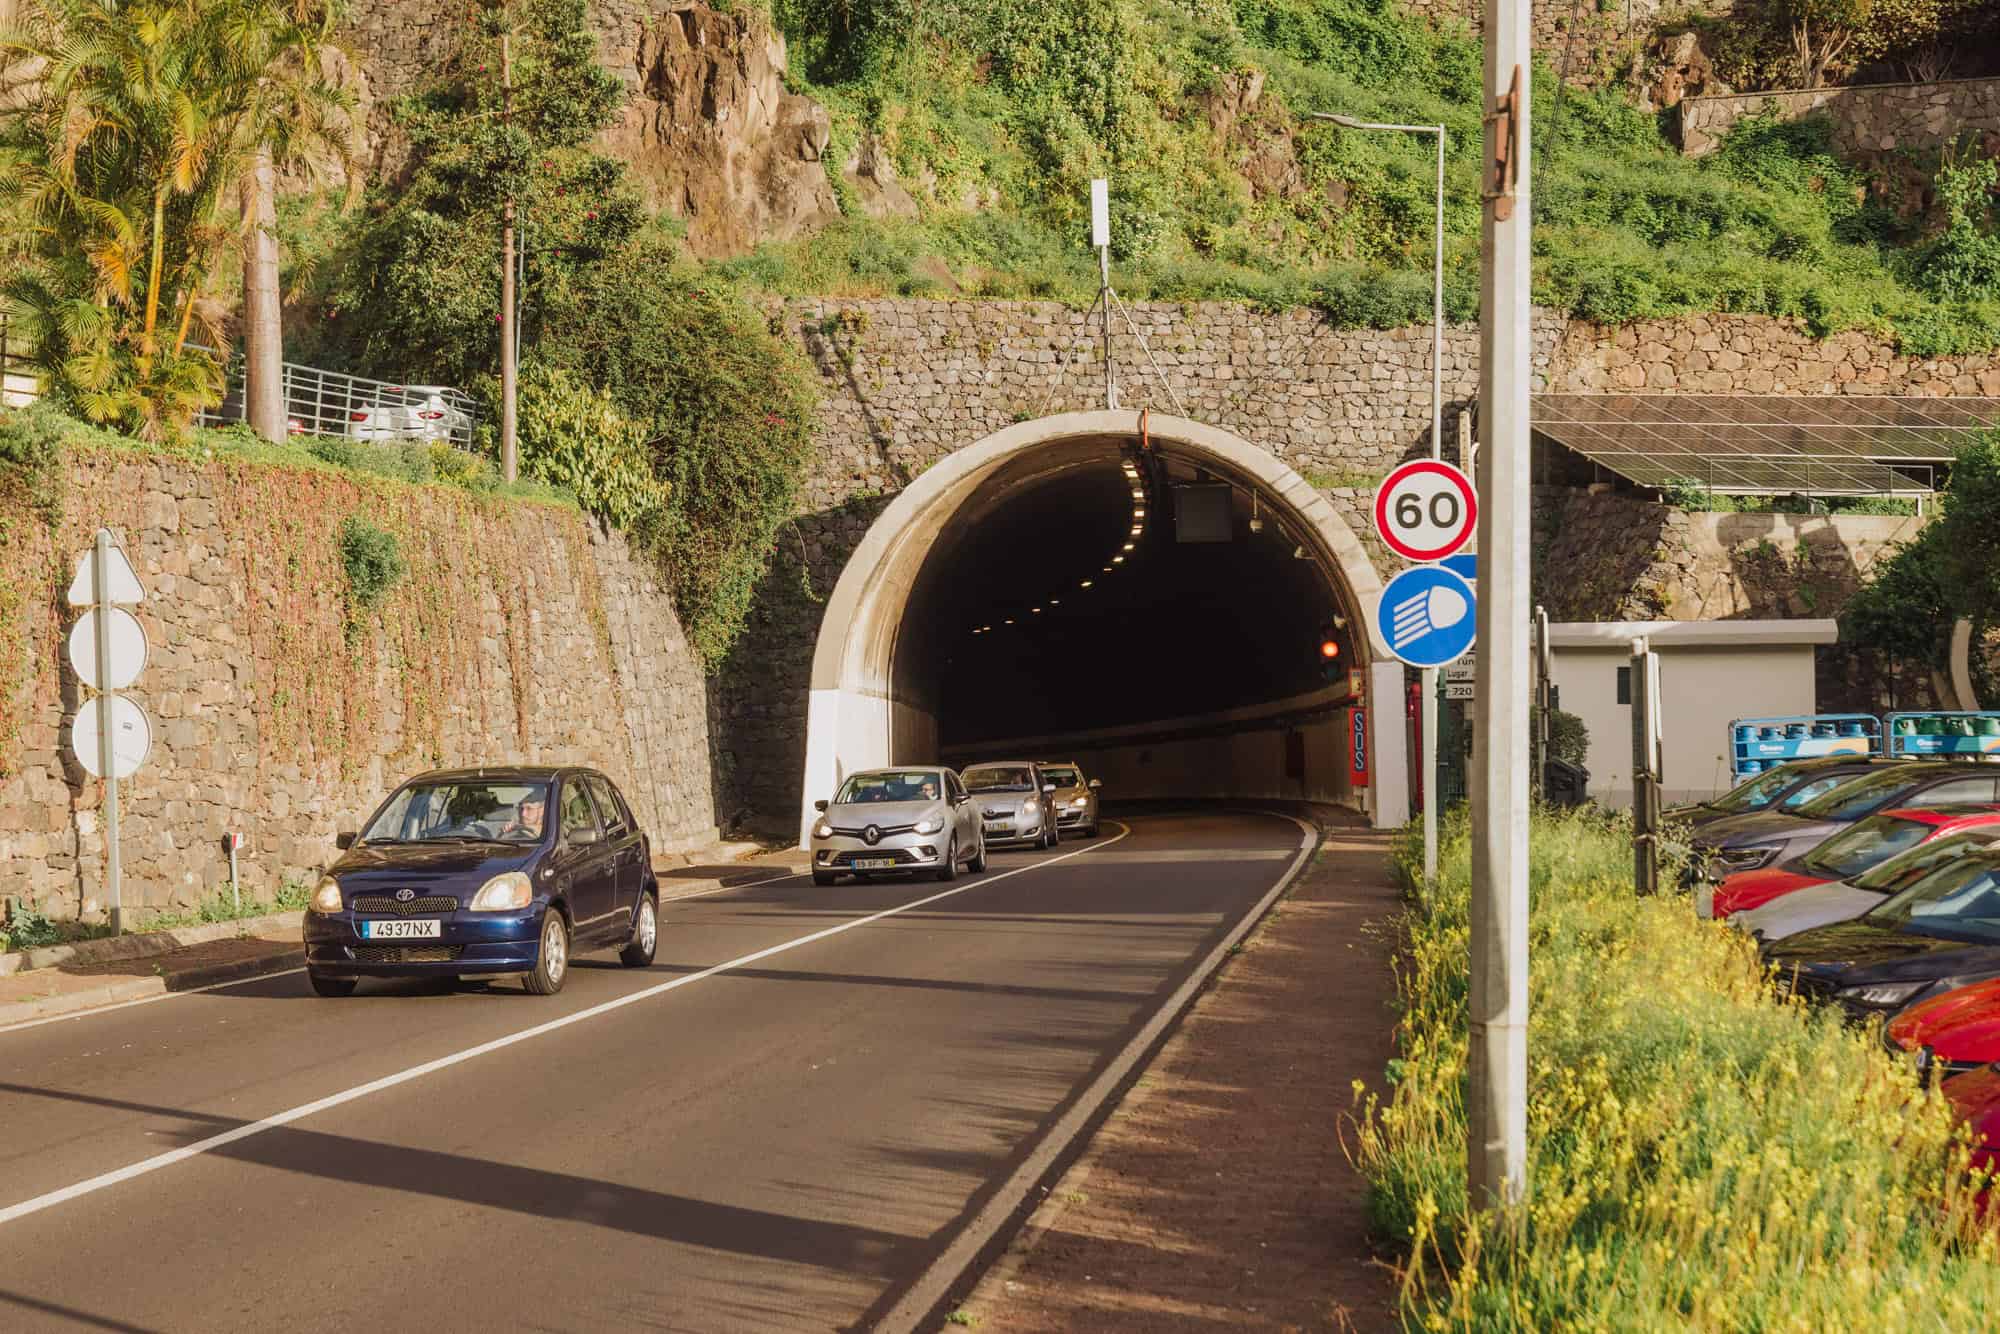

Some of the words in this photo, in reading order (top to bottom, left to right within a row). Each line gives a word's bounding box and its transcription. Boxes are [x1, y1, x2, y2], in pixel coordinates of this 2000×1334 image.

[1395, 492, 1459, 529] 60
[1354, 711, 1364, 771] SOS
[376, 921, 433, 936] 4937NX
